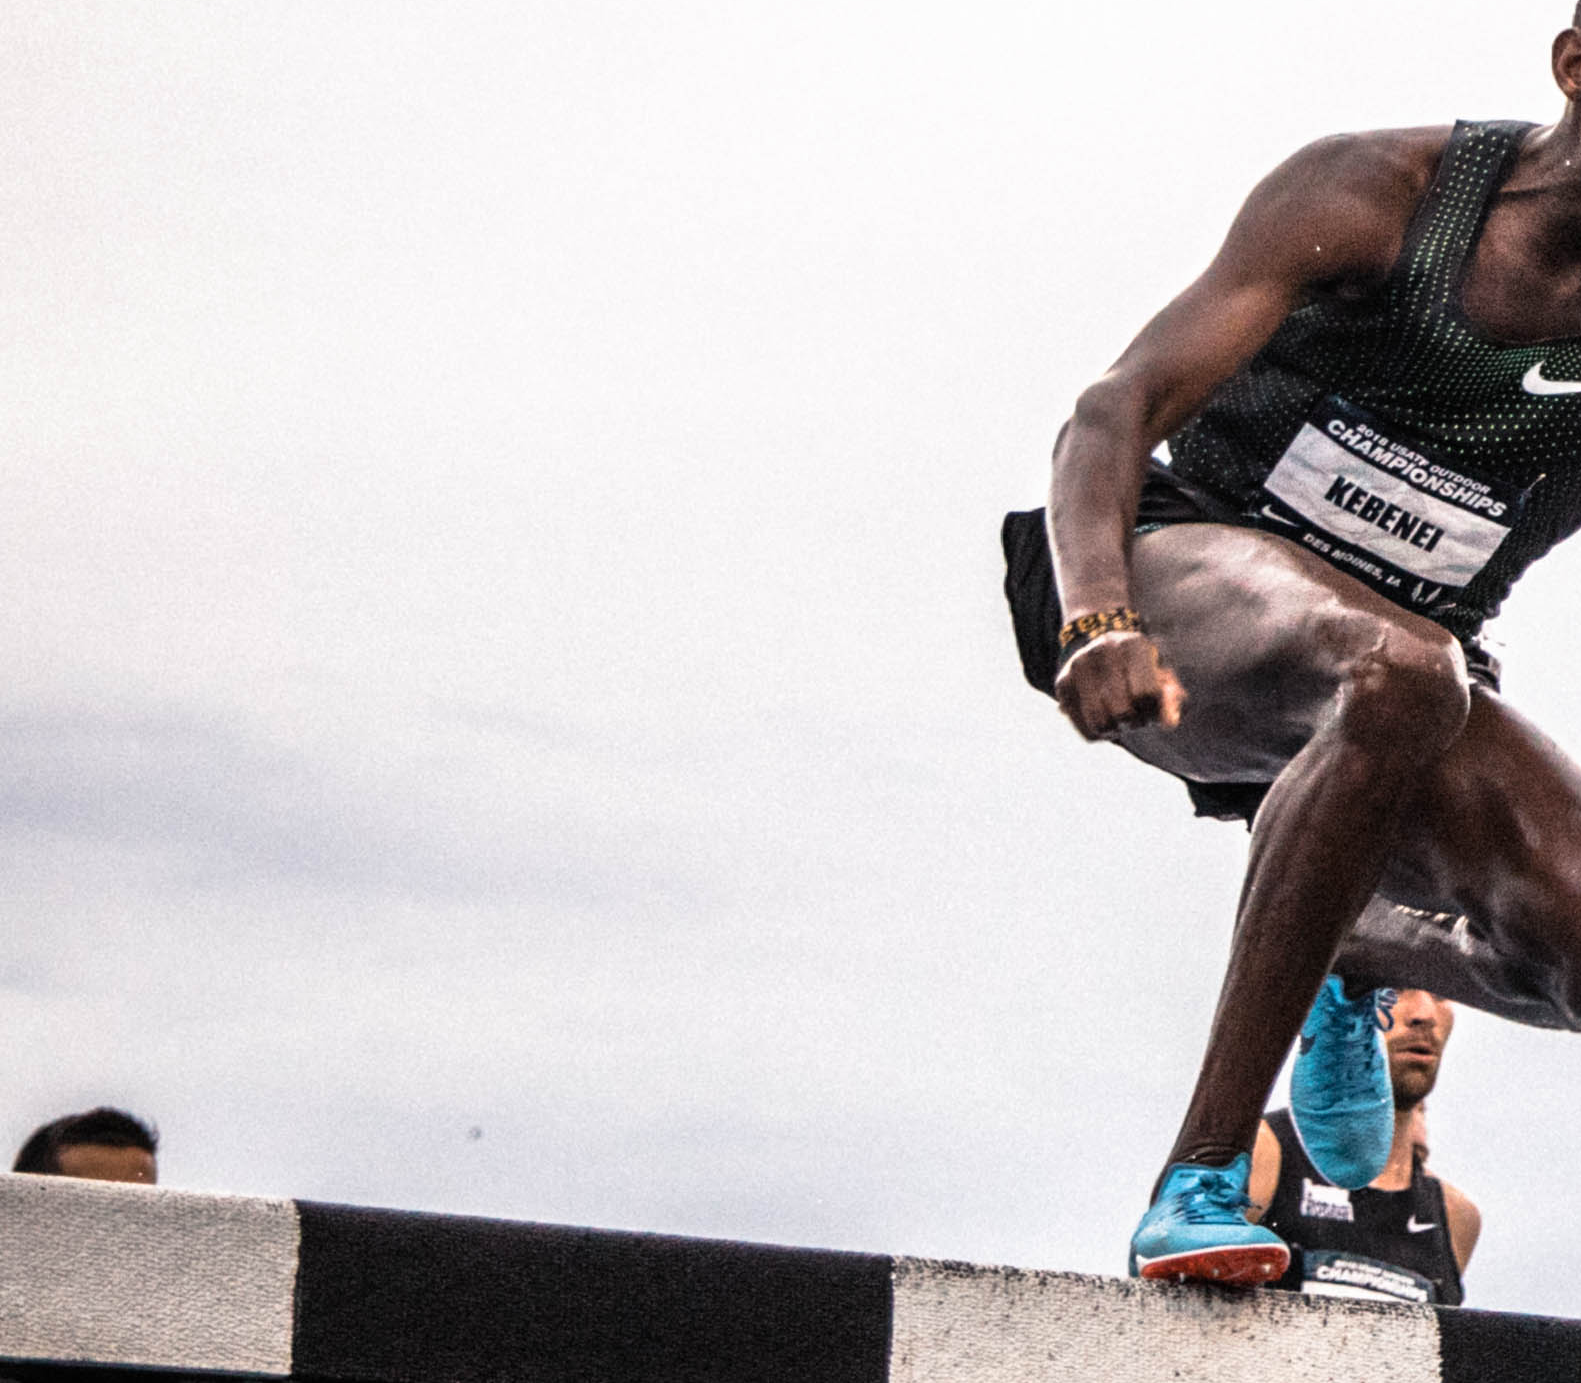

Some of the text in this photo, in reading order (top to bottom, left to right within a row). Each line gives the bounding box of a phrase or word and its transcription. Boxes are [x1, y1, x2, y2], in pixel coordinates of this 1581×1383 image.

[1327, 419, 1507, 517] CHAMPIONSHIPS
[1356, 423, 1492, 494] 2018 USATF OUTDOOR
[1324, 475, 1445, 553] KEBENEI
[1303, 533, 1331, 553] DES
[1331, 549, 1383, 580] MOINES,
